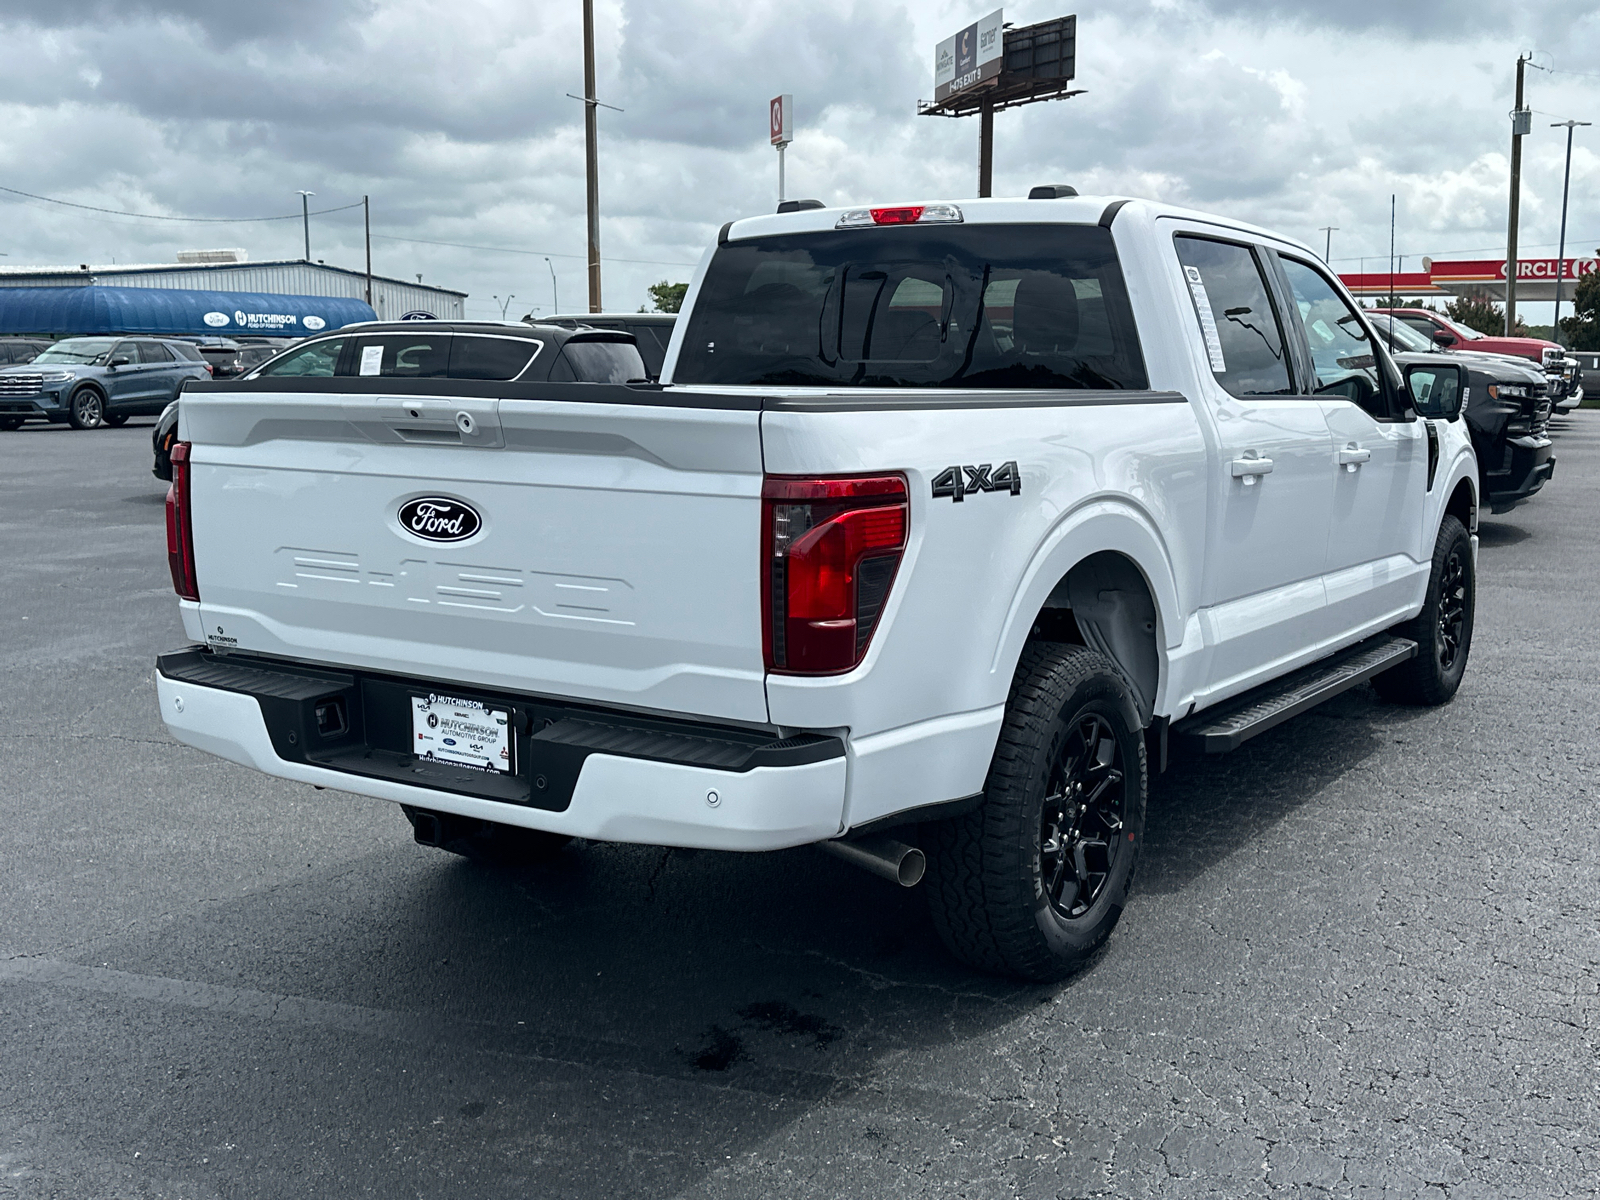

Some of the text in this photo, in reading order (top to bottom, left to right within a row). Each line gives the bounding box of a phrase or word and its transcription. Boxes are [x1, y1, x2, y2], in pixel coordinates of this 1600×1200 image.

[949, 76, 964, 94] I-475
[963, 69, 977, 86] EXIT
[977, 67, 982, 80] 9
[773, 104, 780, 128] K
[1500, 261, 1568, 277] CIRCLE
[247, 313, 297, 325] HUTCHINSON
[411, 502, 465, 535] Ford
[208, 635, 238, 643] HUTCHINSON
[437, 695, 484, 710] HUTCHINSON
[440, 718, 500, 739] HUTCHINSON
[441, 728, 477, 742] AUTOMOTIVE
[477, 735, 498, 745] GROUP
